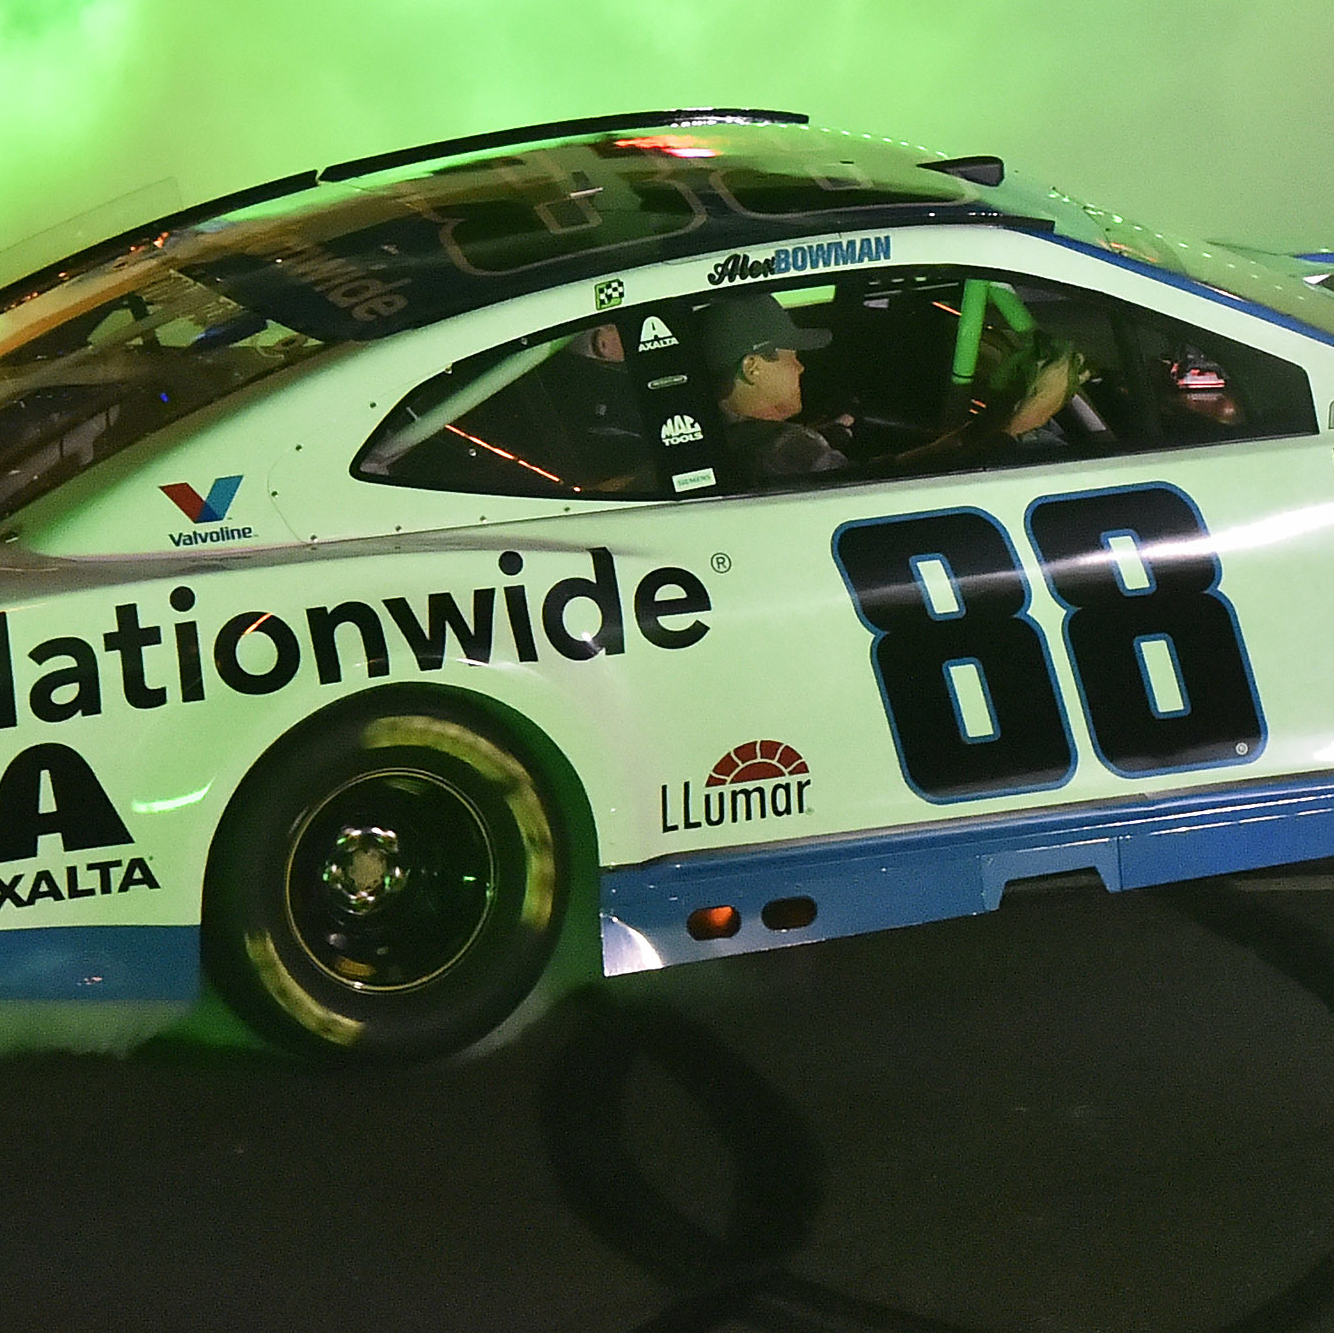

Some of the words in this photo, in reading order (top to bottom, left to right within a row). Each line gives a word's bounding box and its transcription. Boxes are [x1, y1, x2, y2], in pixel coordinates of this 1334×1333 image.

[774, 235, 892, 274] BOWMAN
[638, 337, 680, 353] AXALTA
[661, 415, 700, 439] MAC
[662, 431, 704, 447] TOOLS
[168, 526, 253, 547] Valvoline
[831, 480, 1269, 806] 88
[661, 778, 811, 834] LLumar
